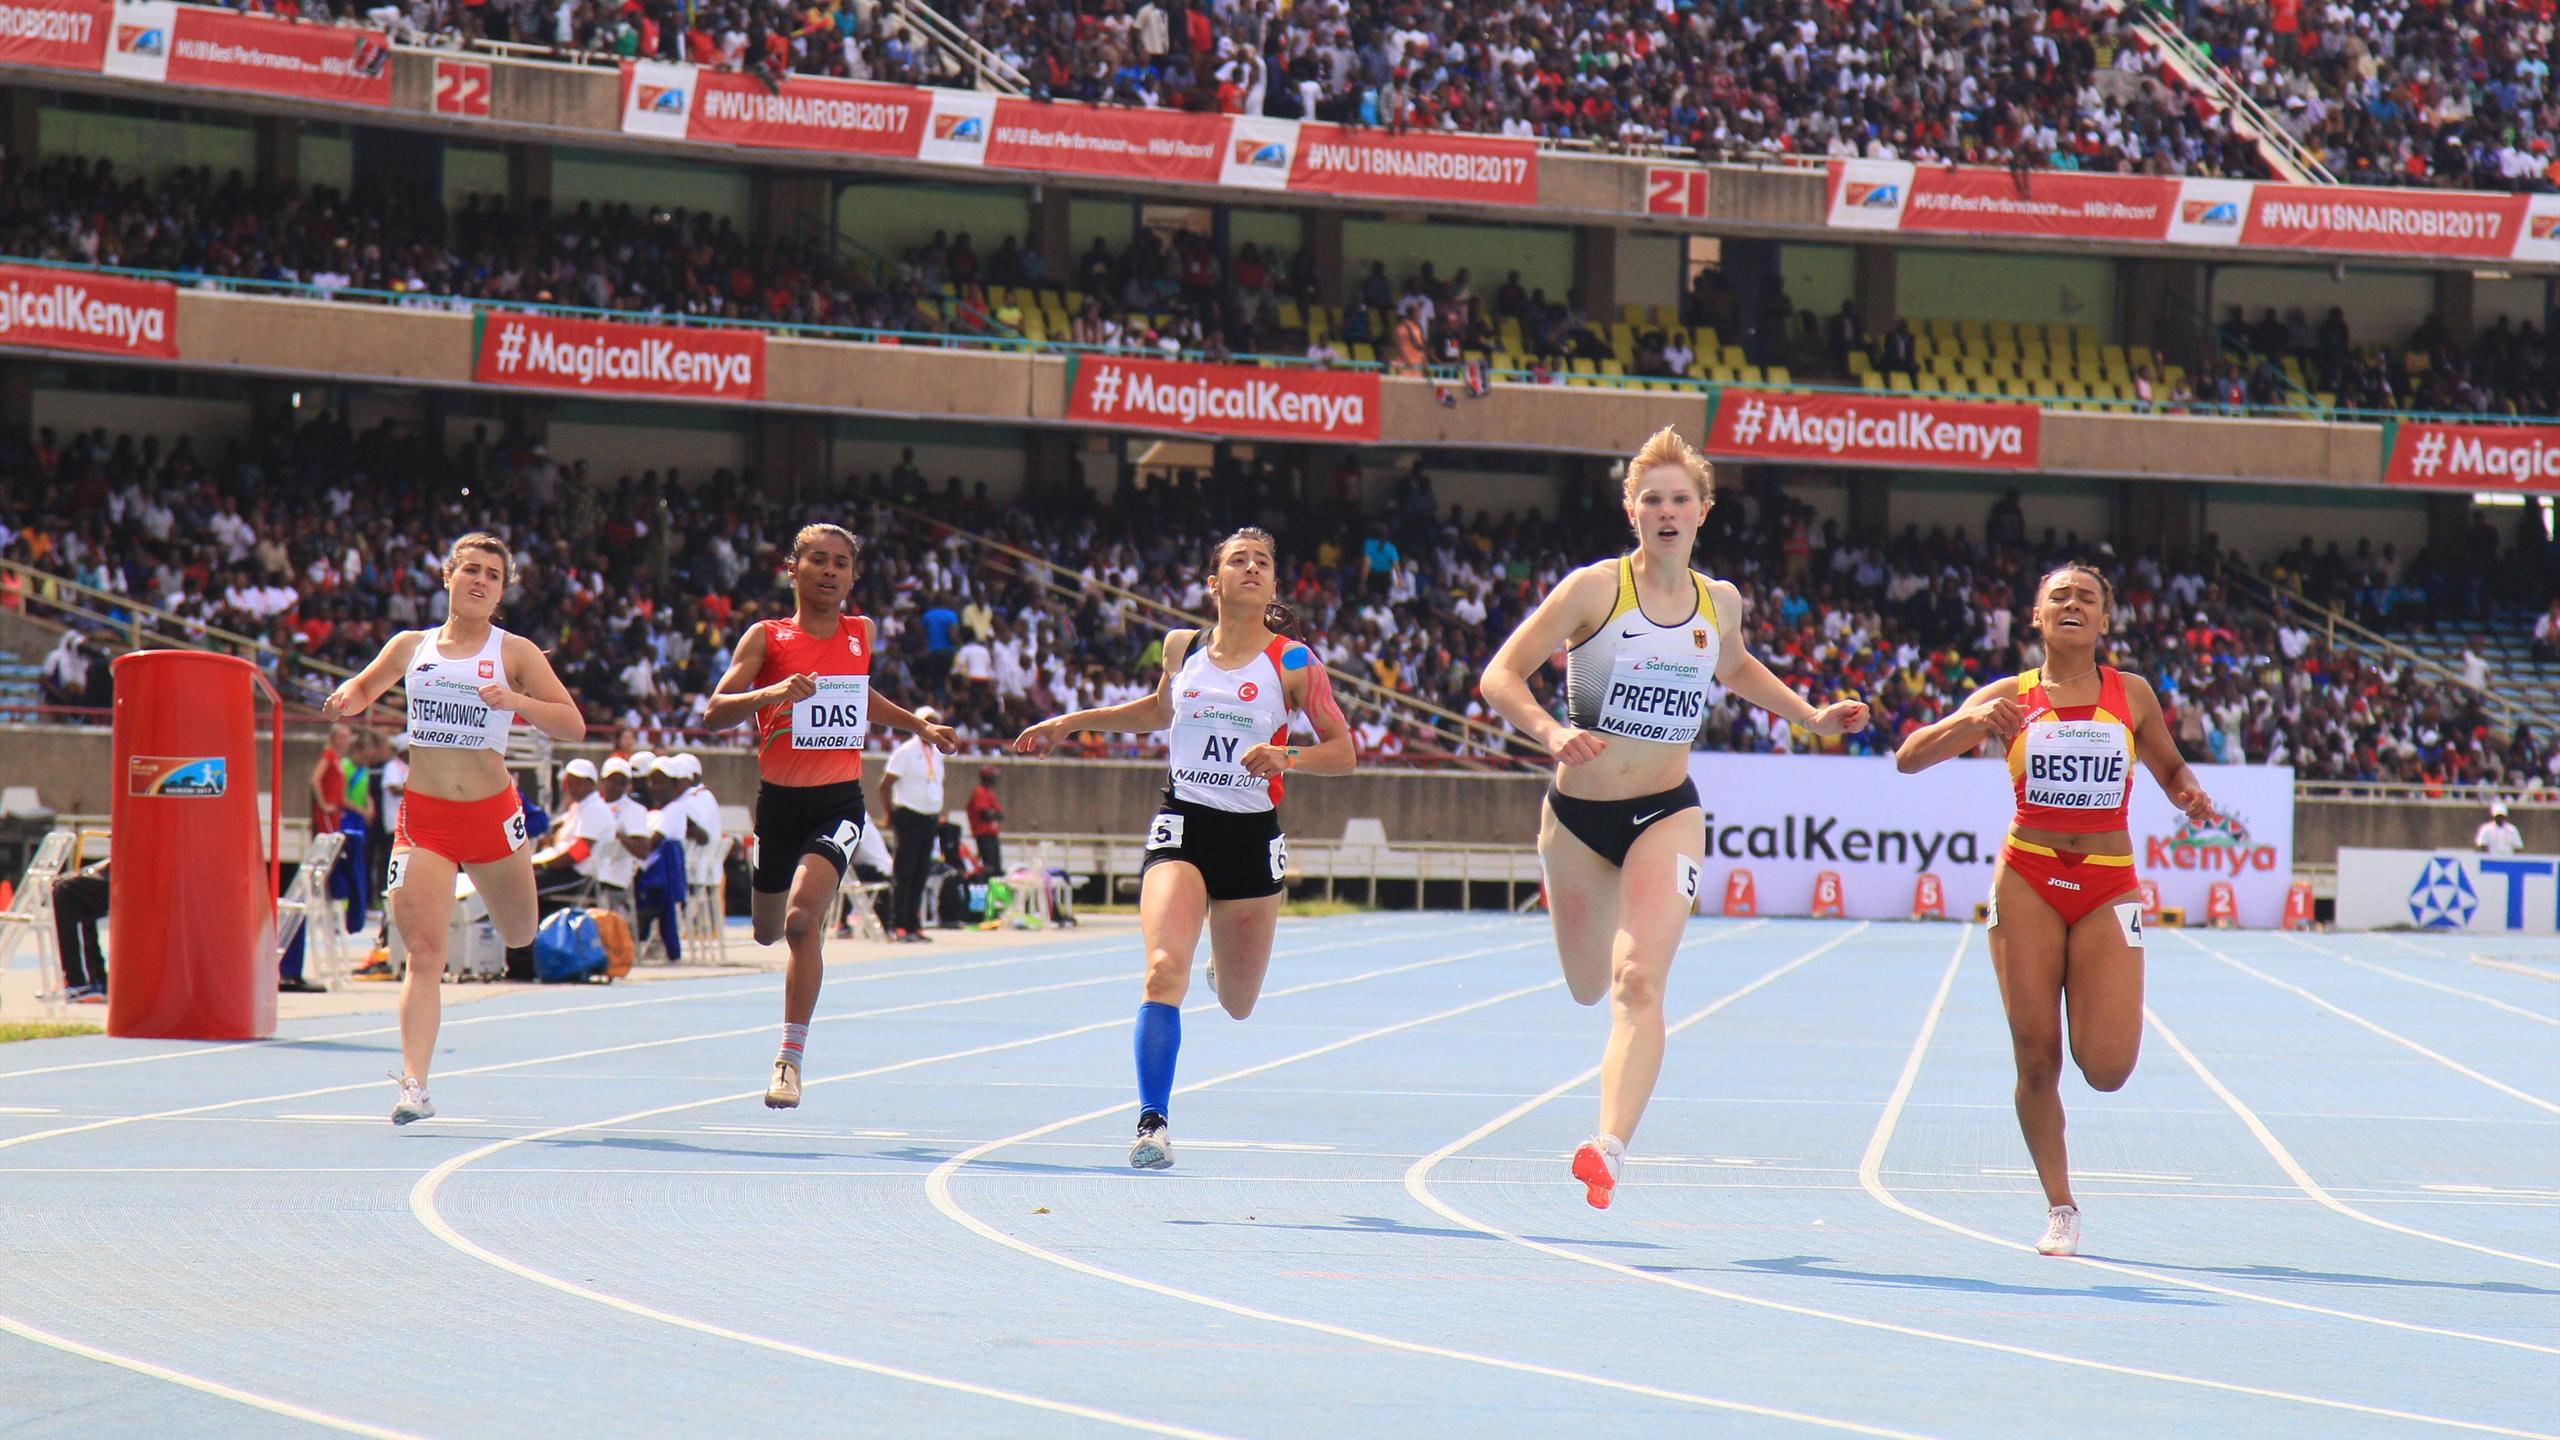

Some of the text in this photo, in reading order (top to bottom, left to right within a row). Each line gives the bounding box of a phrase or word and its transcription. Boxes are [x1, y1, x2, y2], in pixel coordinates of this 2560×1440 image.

[0, 4, 93, 44] ROBI2017
[208, 42, 233, 62] Best
[233, 44, 301, 72] Performance
[437, 63, 490, 116] 22
[704, 89, 910, 134] #WU18NAIROBI2017
[1029, 128, 1054, 147] Best
[1055, 129, 1128, 153] Performance
[1175, 139, 1215, 160] Record
[1307, 142, 1528, 185] #WU18NAIROBI2017
[1649, 169, 1709, 217] 21
[1951, 193, 1978, 213] Best
[1978, 194, 2060, 217] Performance
[2112, 203, 2157, 220] Record
[2261, 201, 2502, 239] #WU18NAIROBI2017
[0, 280, 165, 347] gicalKenya
[496, 321, 752, 392] #MagicalKenya
[1090, 364, 1364, 432] #MagicalKenya
[1733, 398, 2023, 460] #MagicalKenya
[2412, 431, 2560, 483] #Magic
[1646, 660, 1699, 674] Safaricom
[434, 679, 479, 692] Safaricom
[818, 681, 861, 691] Safaricom
[411, 698, 488, 728] STEFANOWICZ
[1609, 682, 1703, 718] PREPENS
[811, 704, 858, 728] DAS
[1203, 709, 1254, 725] Safaricom
[1601, 716, 1697, 741] NAIROBI 2017
[2025, 706, 2046, 723] oma
[412, 729, 486, 747] NAIROBI 2017
[795, 735, 865, 748] NAIROBI 20
[2058, 728, 2111, 739] Safaricom
[1202, 735, 1240, 763] AY
[1175, 768, 1264, 788] NAIROBI 2017
[2031, 750, 2124, 783] BESTUÉ
[2029, 789, 2121, 807] NAIROBI 2017
[513, 816, 525, 840] 8
[843, 826, 857, 846] 7
[1705, 813, 1995, 872] icalKenya.
[2146, 835, 2277, 877] Kenya
[1687, 866, 1698, 897] 5
[1732, 877, 1748, 900] 7
[1819, 879, 1837, 903] 6
[1922, 882, 1938, 906] 5
[2480, 859, 2560, 930] T
[2141, 887, 2156, 911] 3
[2214, 889, 2232, 913] 2
[2293, 891, 2305, 915] 1
[2130, 910, 2142, 940] 4
